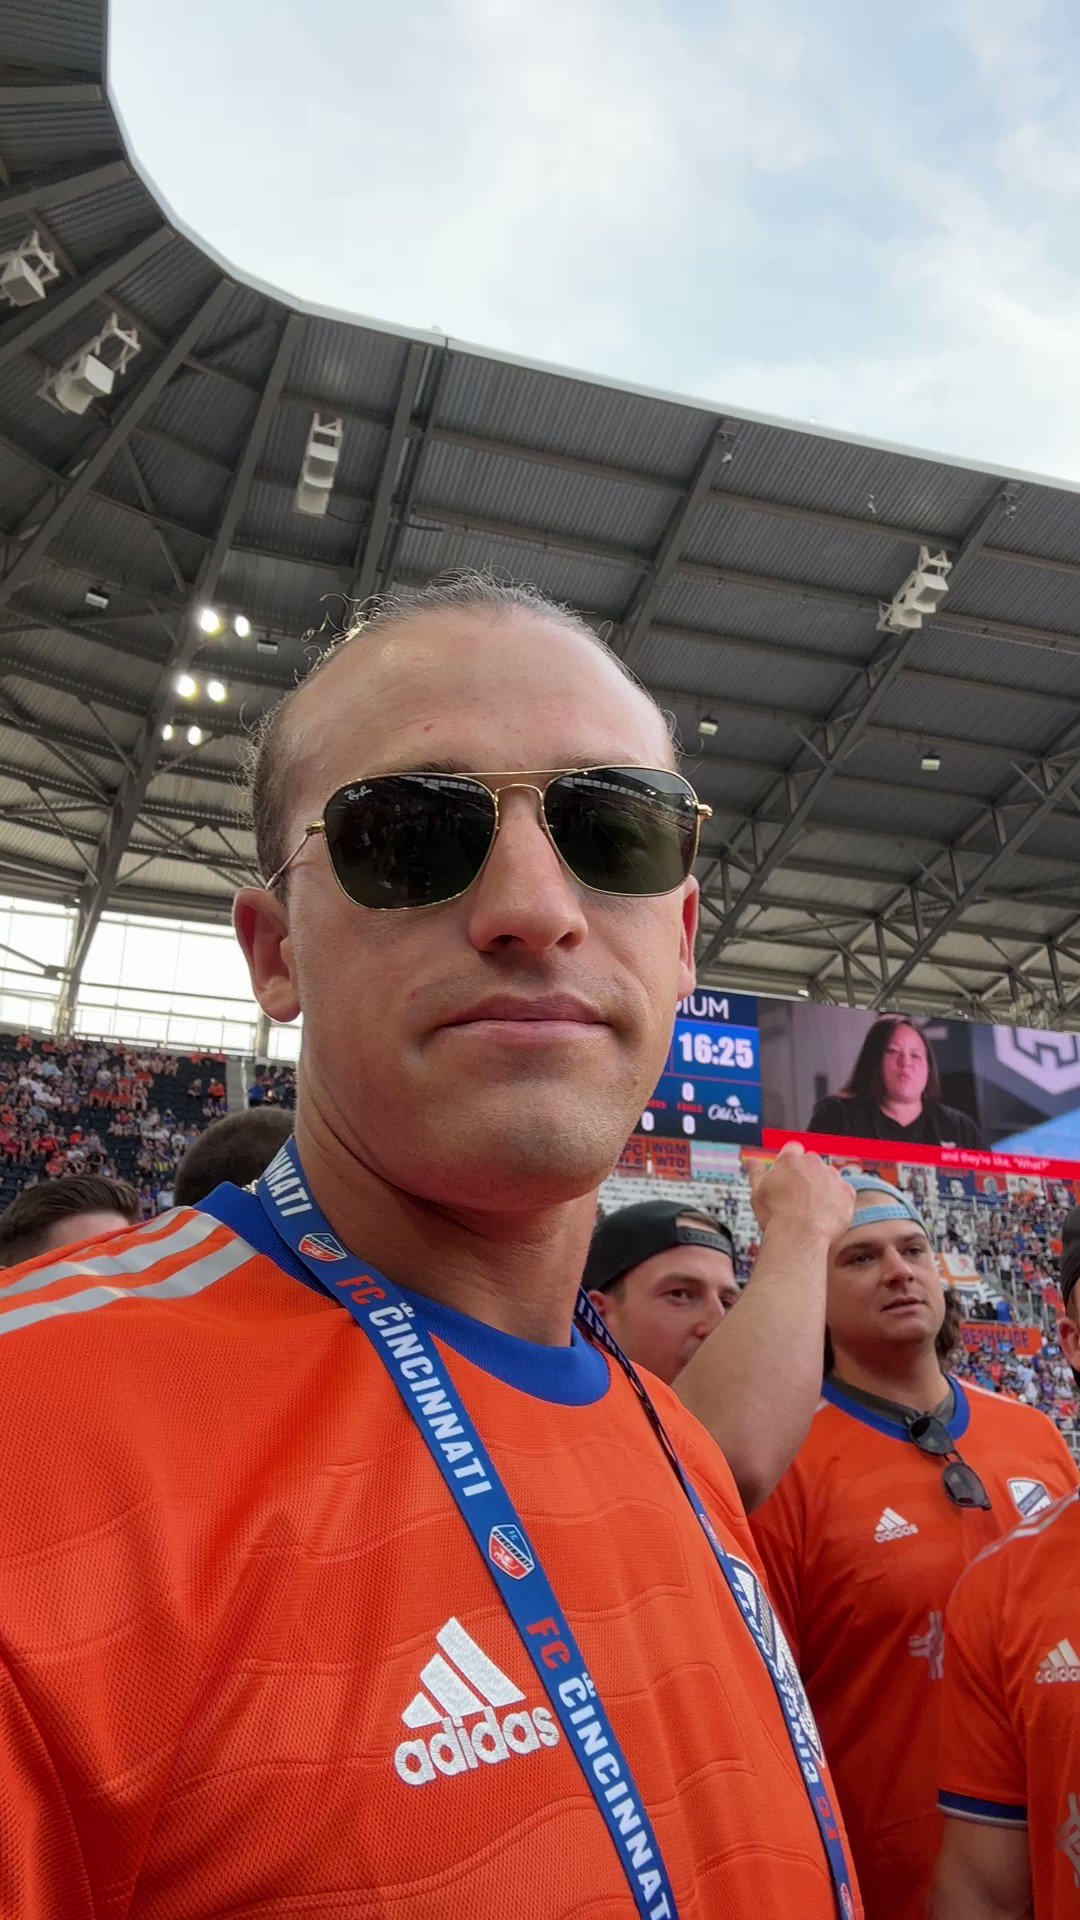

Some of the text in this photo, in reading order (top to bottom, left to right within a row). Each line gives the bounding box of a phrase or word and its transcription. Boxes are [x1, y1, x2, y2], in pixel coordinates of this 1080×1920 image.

[678, 1032, 754, 1069] 16:25
[681, 1081, 695, 1102] 0
[641, 1111, 655, 1131] 0
[683, 1114, 696, 1134] 0
[335, 1273, 492, 1497] FC CINCINNATI
[874, 1523, 919, 1544] adidas
[527, 1615, 570, 1670] FC
[394, 1705, 560, 1787] adidas
